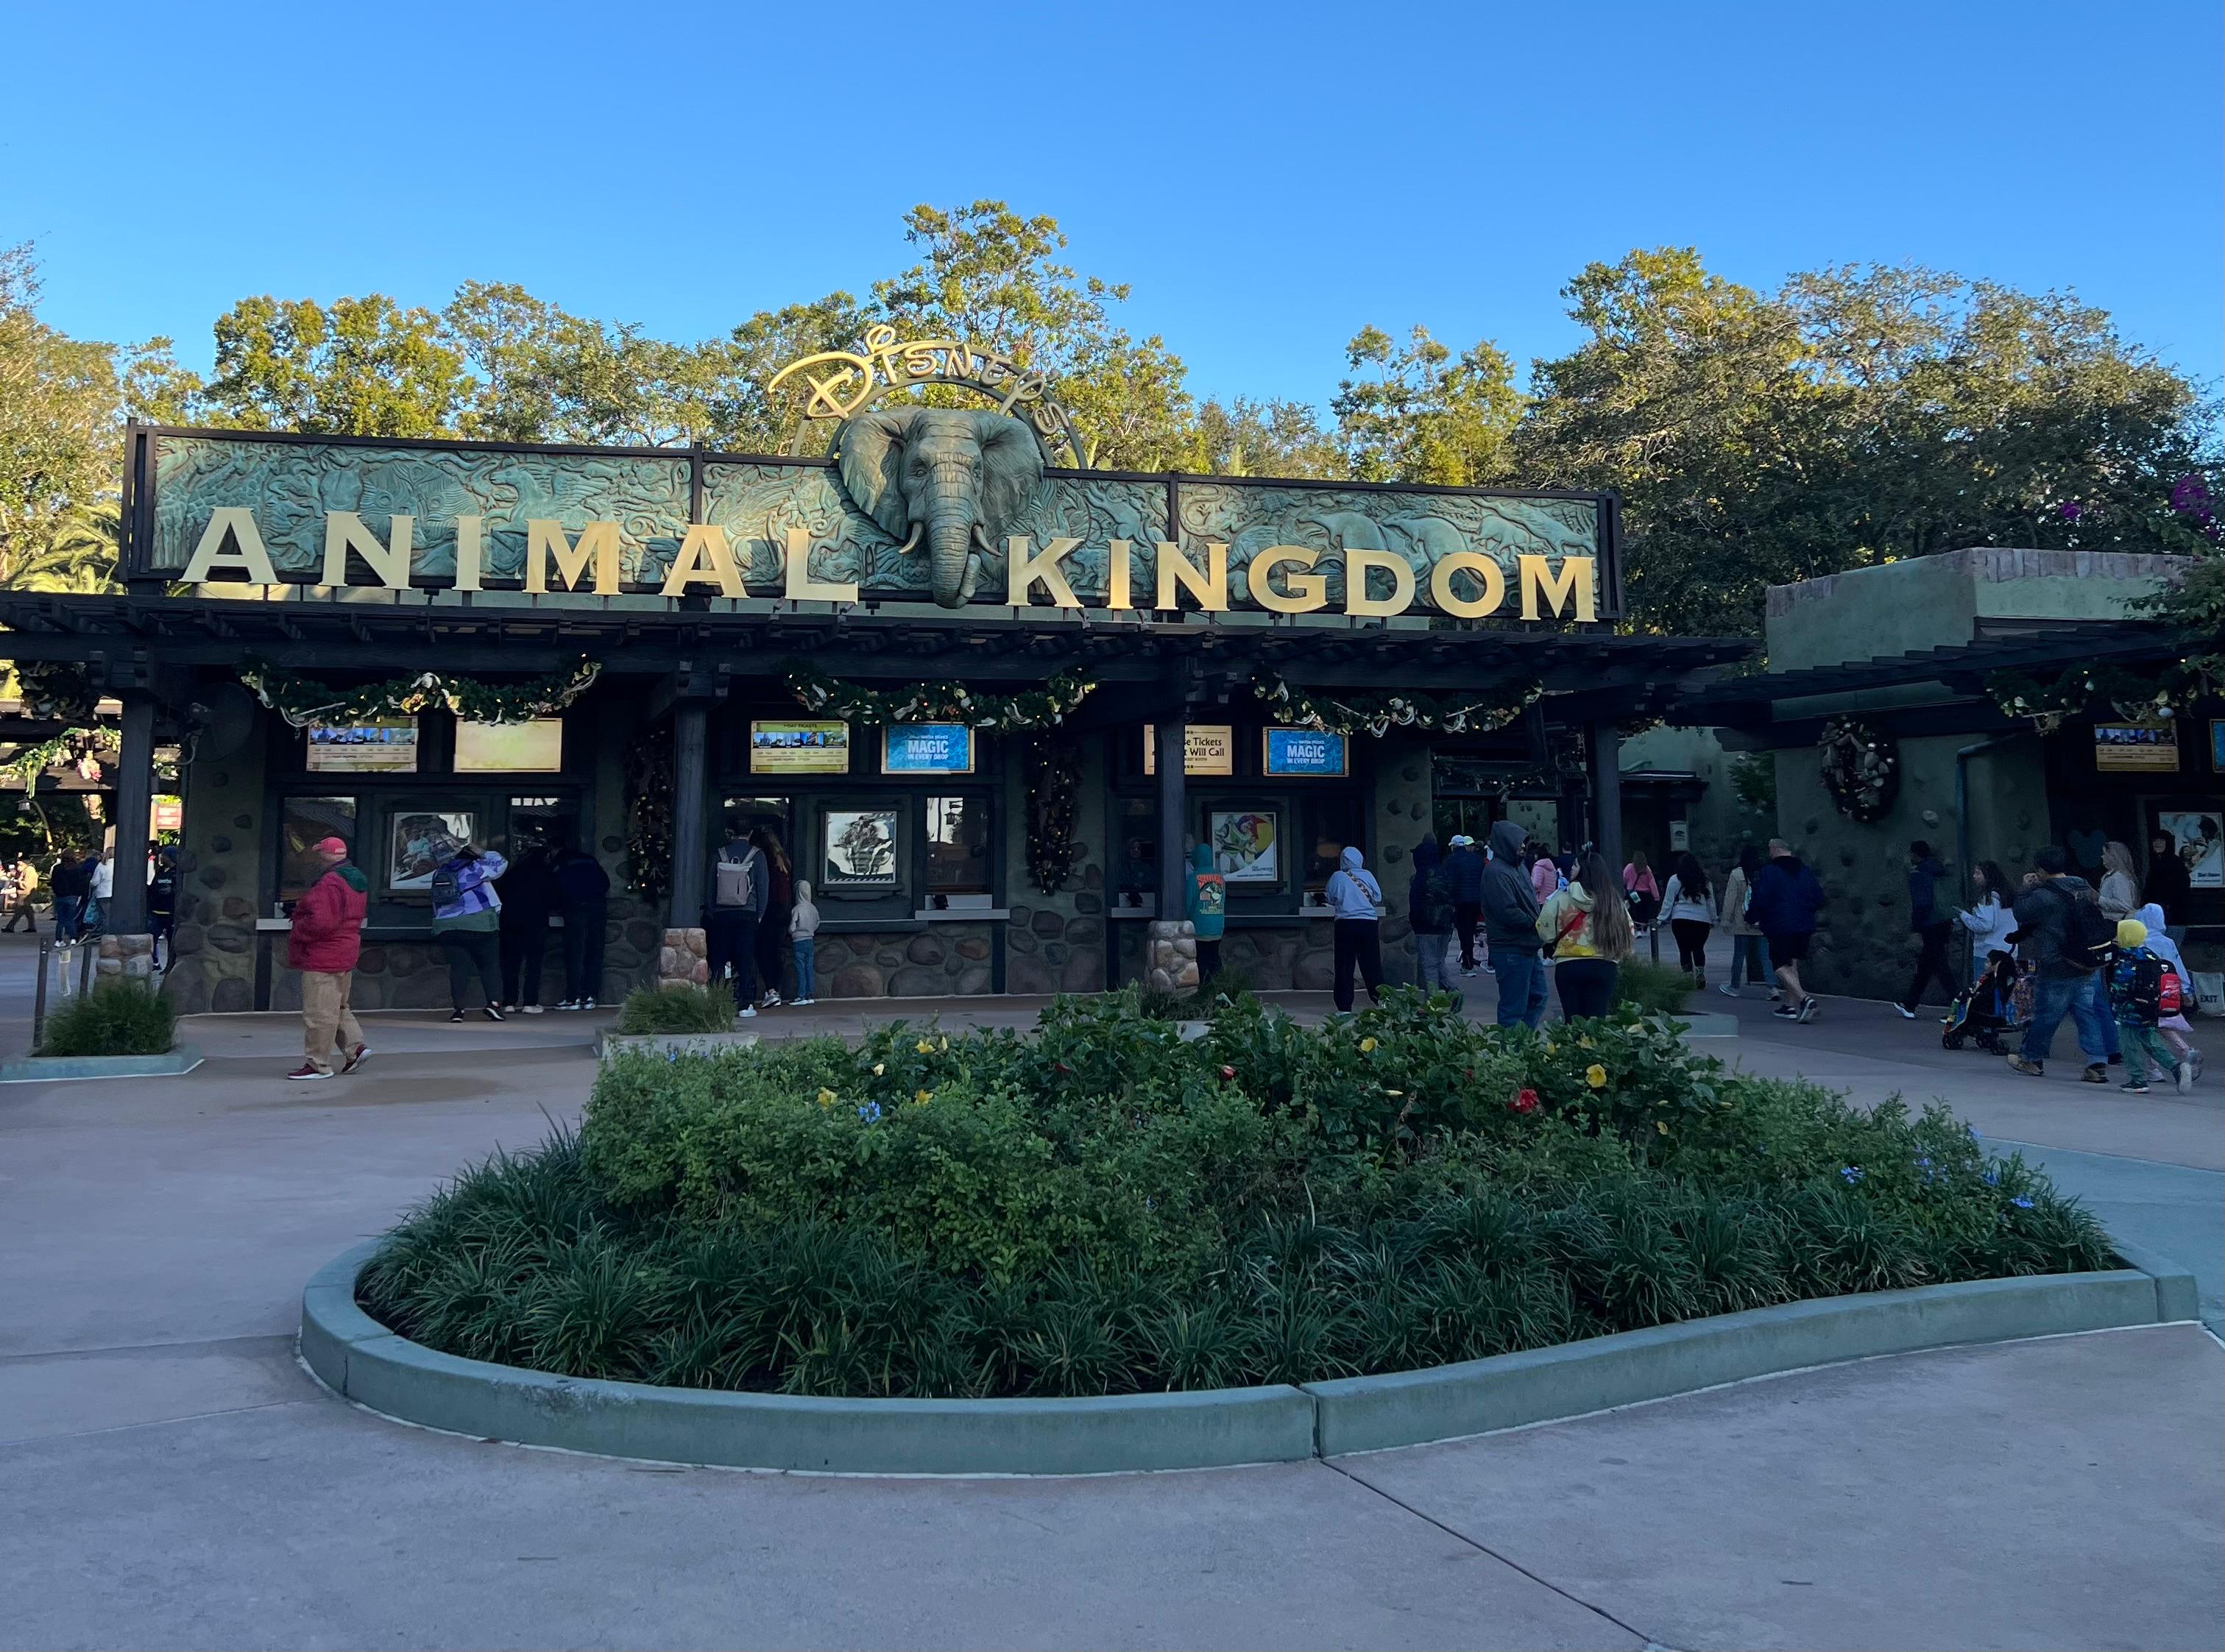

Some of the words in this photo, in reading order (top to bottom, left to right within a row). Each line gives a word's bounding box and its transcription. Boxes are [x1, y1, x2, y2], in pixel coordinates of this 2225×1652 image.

[177, 506, 859, 606] ANIMAL
[1004, 536, 1598, 623] KINGDOM
[908, 740, 949, 754] MAGIC
[1192, 737, 1222, 746] Tickets
[1189, 747, 1206, 756] Will
[1209, 747, 1225, 756] Call
[1287, 745, 1326, 758] MAGIC
